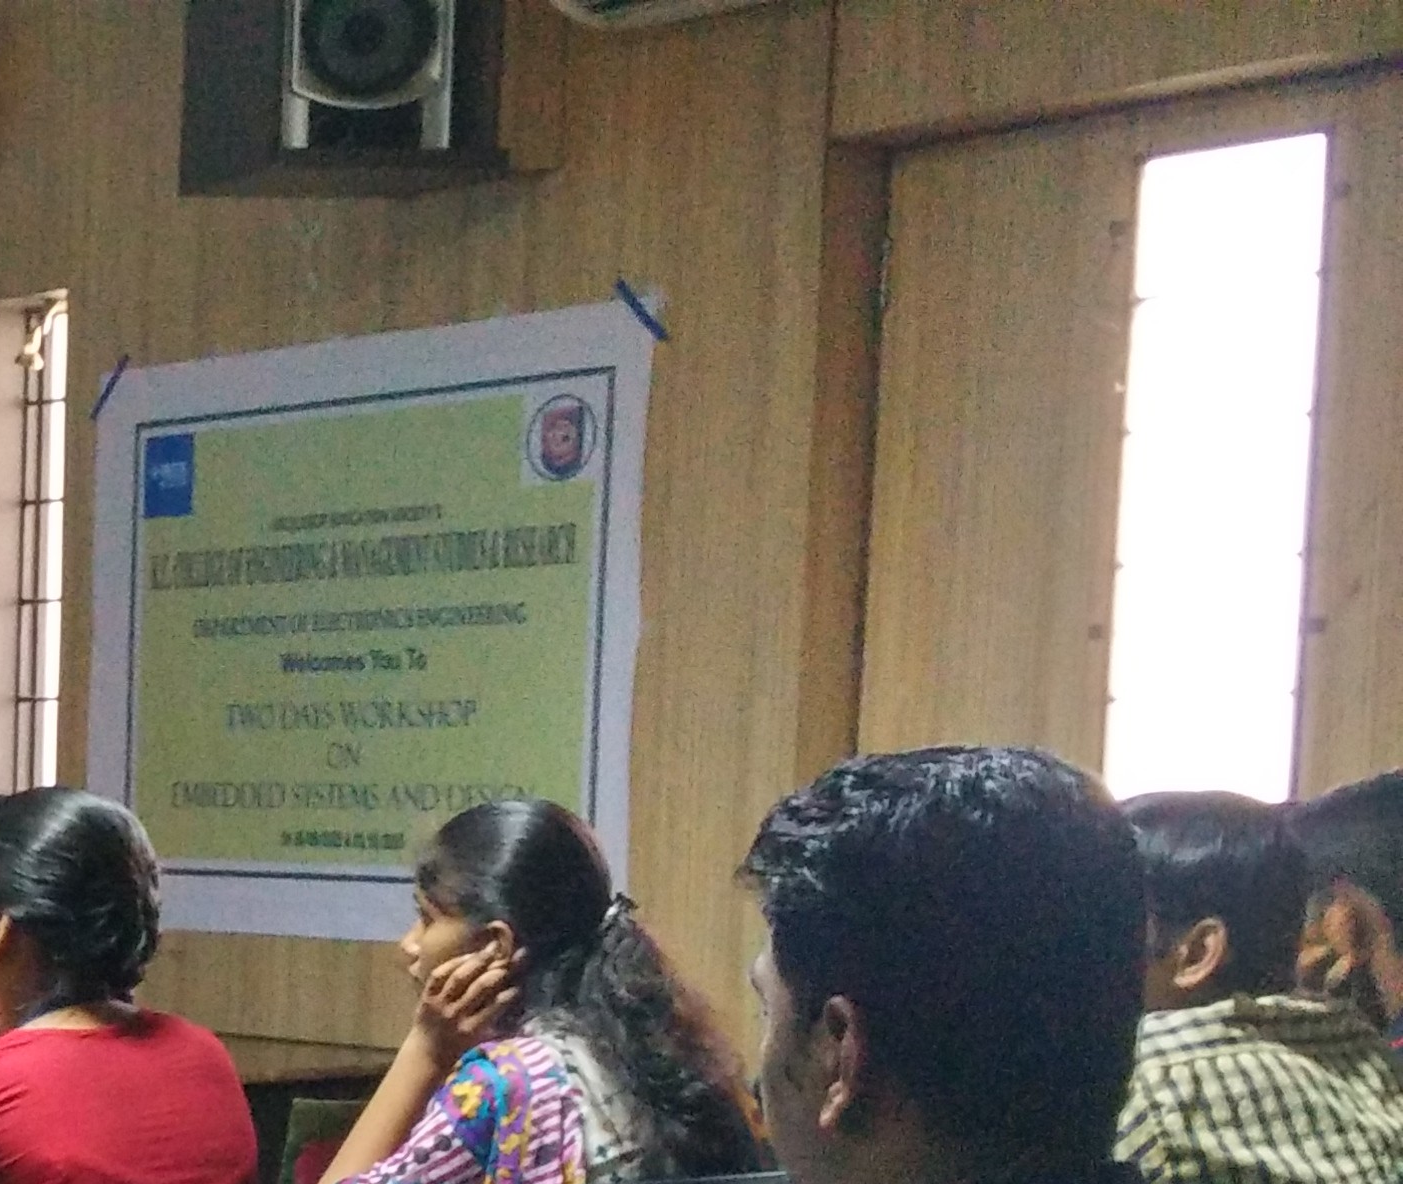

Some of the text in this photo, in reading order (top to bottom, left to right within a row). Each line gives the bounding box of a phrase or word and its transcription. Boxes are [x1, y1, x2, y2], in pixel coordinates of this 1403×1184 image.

[280, 648, 428, 673] Welcomes You To
[226, 698, 478, 731] TWO DAYS WORKSHOP
[326, 741, 362, 770] ON
[171, 780, 287, 809] EMBEDDED
[291, 780, 380, 810] SYSTEMS
[389, 782, 442, 811] AND
